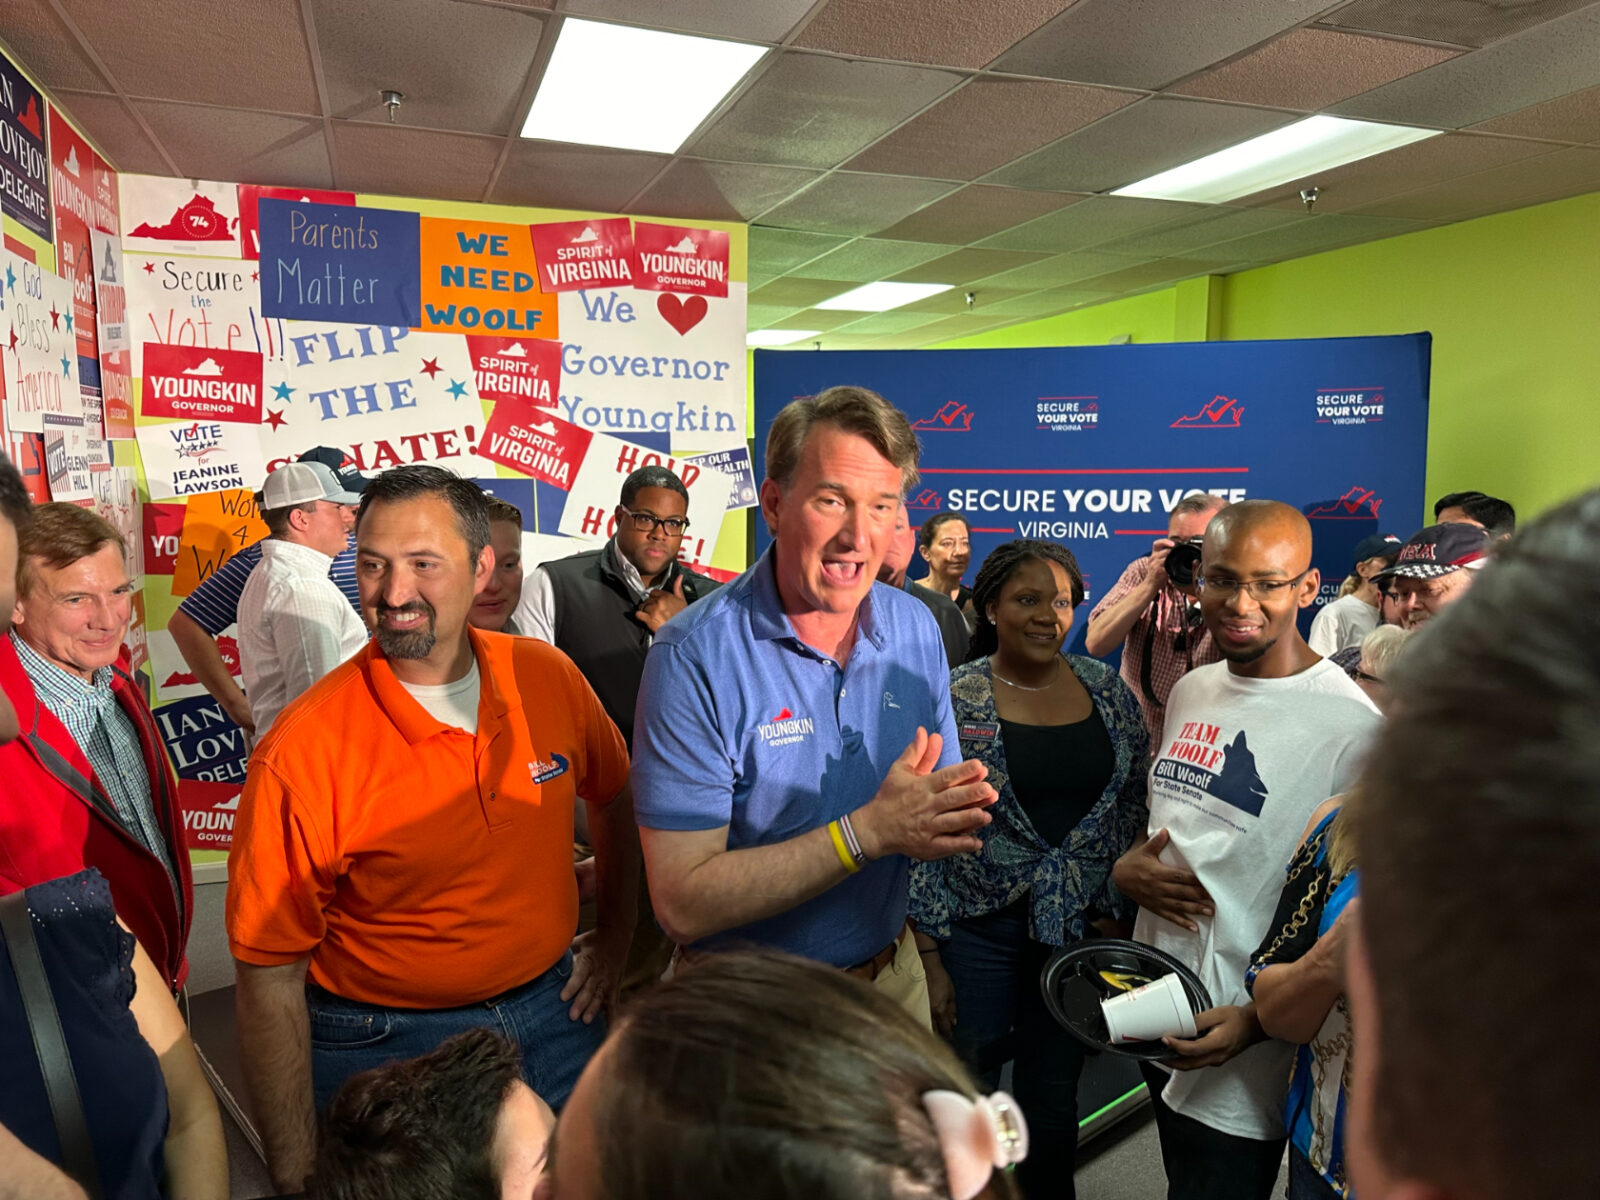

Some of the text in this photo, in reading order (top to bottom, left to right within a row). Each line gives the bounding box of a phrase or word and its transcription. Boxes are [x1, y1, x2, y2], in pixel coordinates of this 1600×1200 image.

[0, 166, 47, 221] DELEGATE
[189, 215, 210, 229] 74
[290, 209, 379, 250] Parents
[456, 231, 509, 257] WE
[556, 245, 604, 261] SPIRIT
[162, 260, 244, 292] Secure
[440, 264, 534, 293] NEED
[545, 258, 632, 286] VIRGINIA
[640, 252, 724, 283] YOUNGKIN
[23, 261, 42, 301] God
[277, 257, 380, 306] Matter
[656, 275, 707, 288] GOVERNOR
[190, 294, 213, 309] the
[577, 289, 637, 323] We
[16, 302, 50, 354] Bless
[424, 303, 543, 331] WOOLF
[289, 325, 410, 368] FLIP
[479, 356, 529, 375] SPIRIT
[561, 344, 730, 381] Governor
[16, 356, 63, 414] America
[150, 375, 257, 408] YOUNGKIN
[171, 401, 235, 414] GOVERNOR
[309, 378, 418, 422] THE
[1036, 403, 1080, 412] SECURE
[1316, 394, 1364, 405] SECURE
[1316, 405, 1384, 417] YOUR VOTE
[558, 395, 737, 433] Youngkin
[1036, 413, 1098, 423] YOUR VOTE
[1332, 417, 1366, 425] VIRGINIA
[507, 425, 557, 451] SPIRIT
[67, 455, 89, 472] GLENN
[197, 456, 210, 467] for
[489, 432, 571, 484] VIRGINIA
[708, 452, 731, 466] OUR
[73, 474, 88, 491] HILL
[173, 463, 240, 485] JEANINE
[174, 476, 244, 496] LAWSON
[947, 489, 1056, 512] SECURE
[1062, 489, 1152, 513] YOUR
[232, 525, 249, 546] 4
[1018, 521, 1109, 539] VIRGINIA
[157, 701, 225, 742] IAN
[757, 718, 815, 742] YOUNGKIN
[1178, 721, 1221, 746] TEAM
[769, 735, 805, 747] GOVERNOR
[1167, 740, 1223, 769] WOOLF
[1156, 761, 1213, 790] Bill Woolf
[1152, 777, 1203, 801] For State Senate
